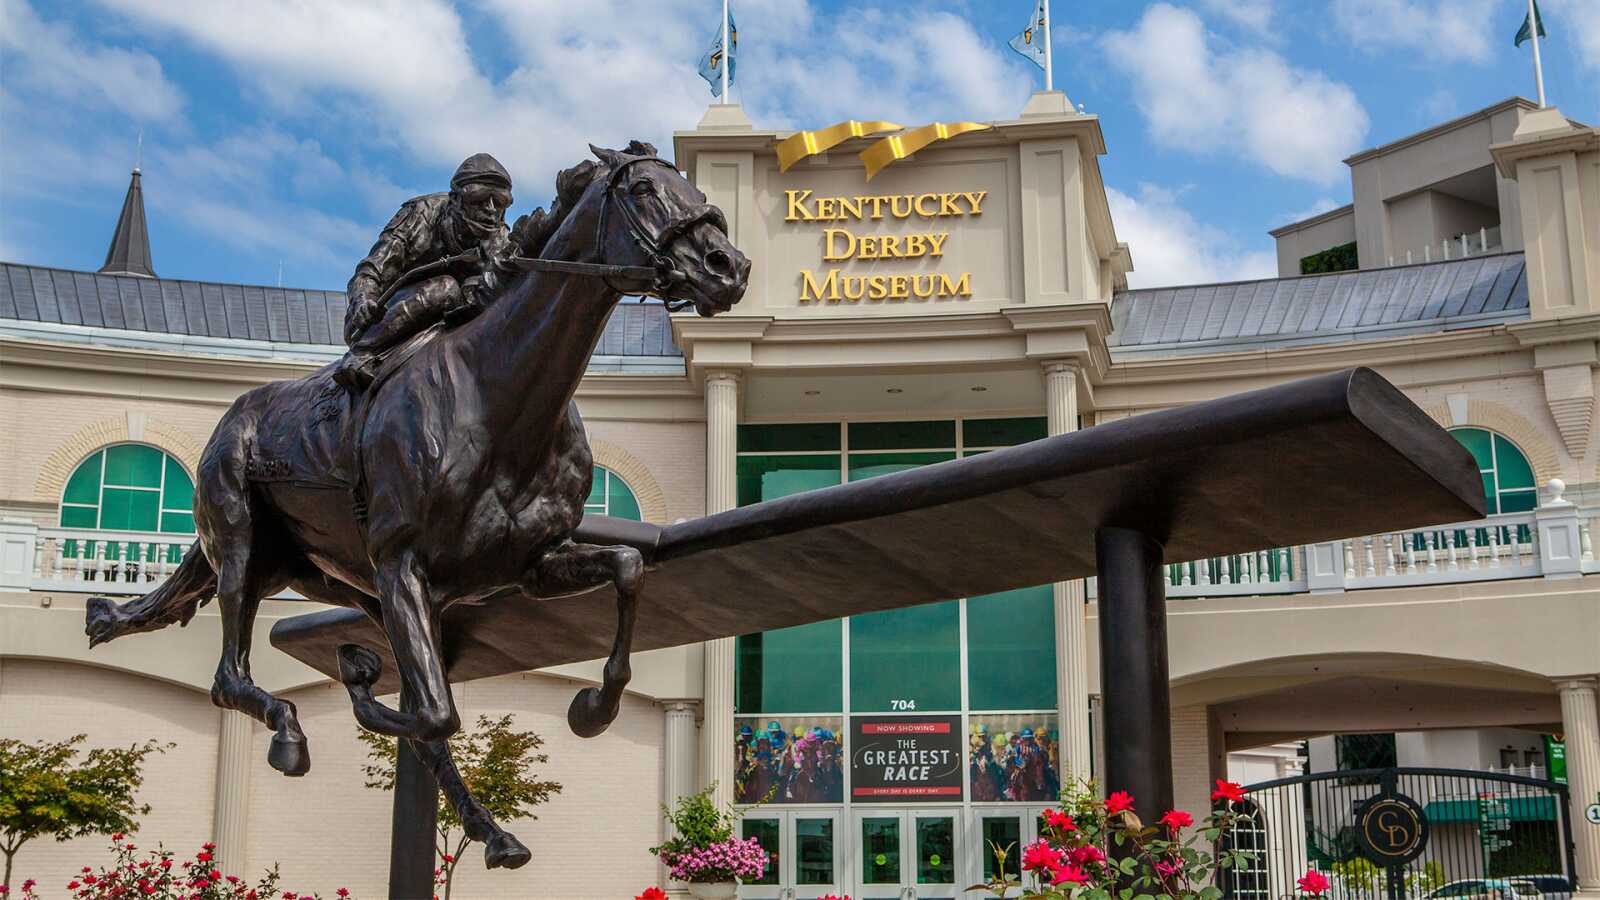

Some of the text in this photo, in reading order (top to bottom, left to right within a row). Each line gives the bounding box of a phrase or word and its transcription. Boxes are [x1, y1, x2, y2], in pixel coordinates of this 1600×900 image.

[784, 190, 987, 221] KENTUCKY
[823, 228, 948, 261] DERBY
[799, 268, 972, 301] MUSEUM
[890, 699, 916, 711] 704
[896, 739, 917, 749] THE
[863, 750, 950, 766] GREATEST
[883, 766, 931, 781] RACE
